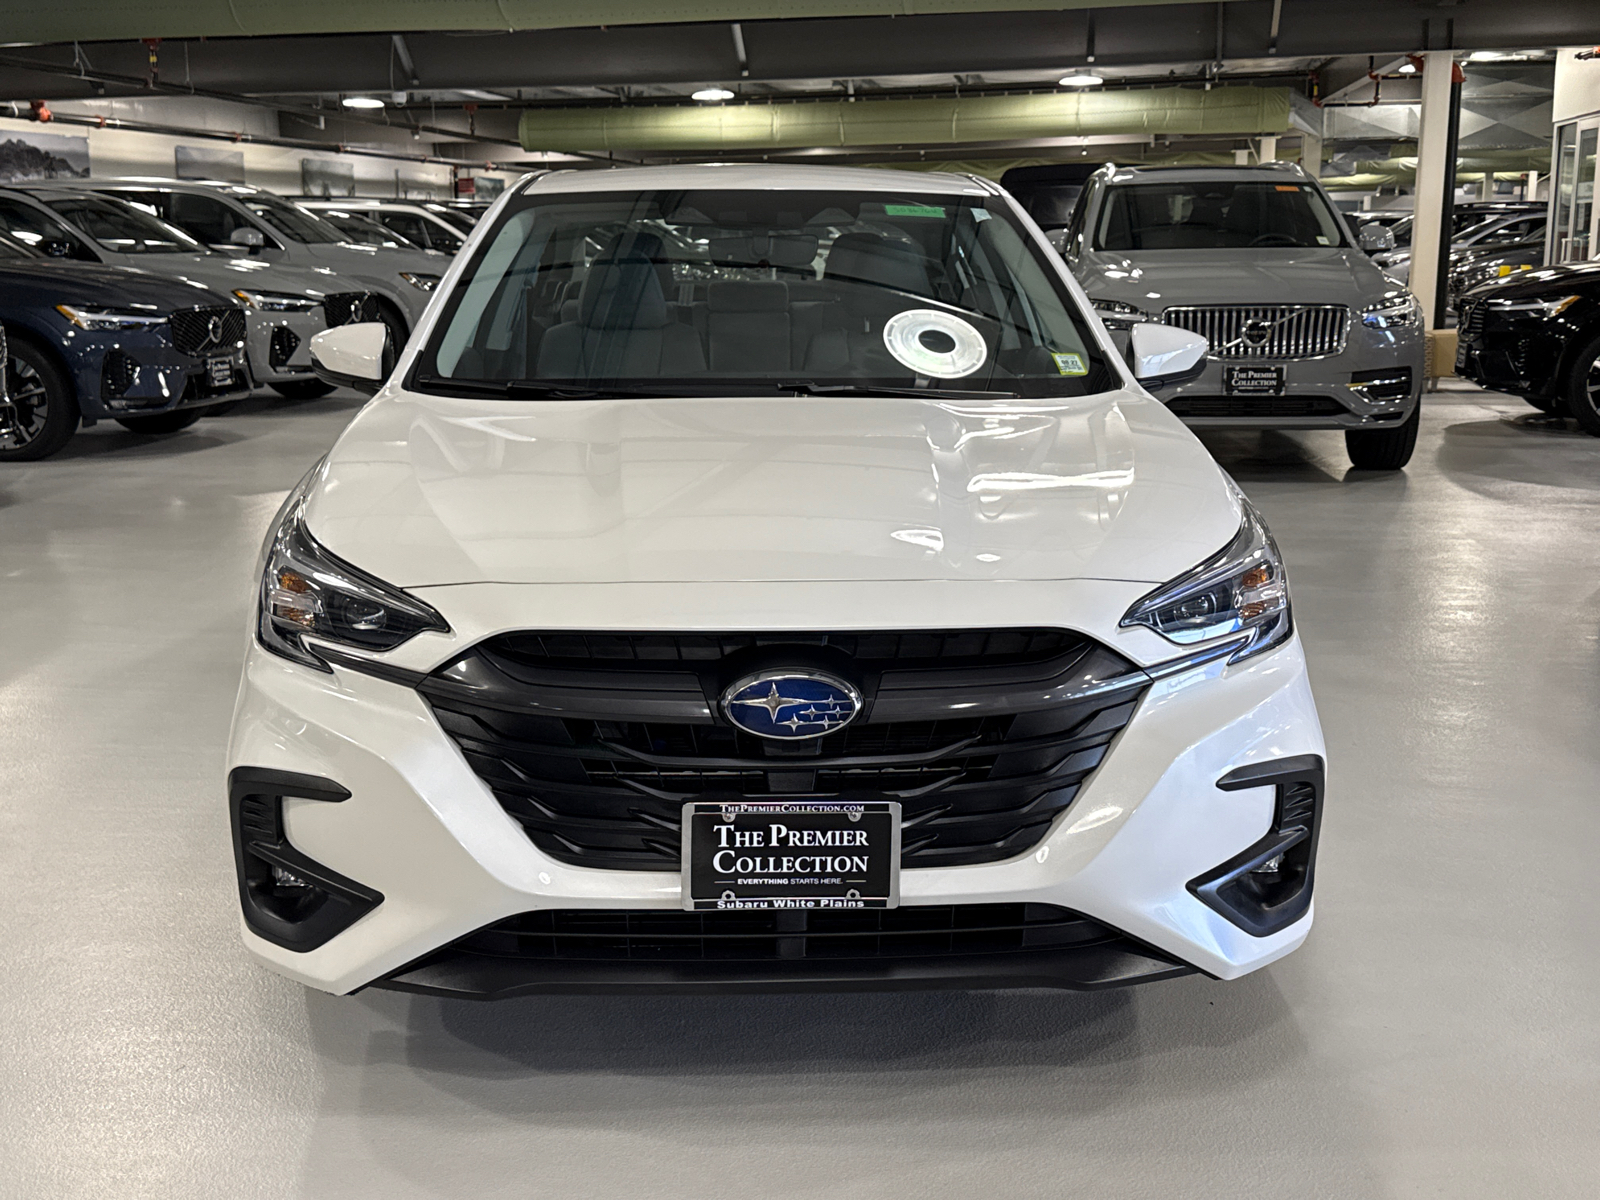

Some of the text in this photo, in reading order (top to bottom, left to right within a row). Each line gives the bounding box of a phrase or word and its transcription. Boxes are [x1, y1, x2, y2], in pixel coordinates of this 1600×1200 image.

[1231, 378, 1277, 386] COLLECTION
[713, 824, 869, 848] THE PREMIER
[712, 849, 869, 874] COLLECTION
[717, 899, 865, 909] Subaru White Plains
